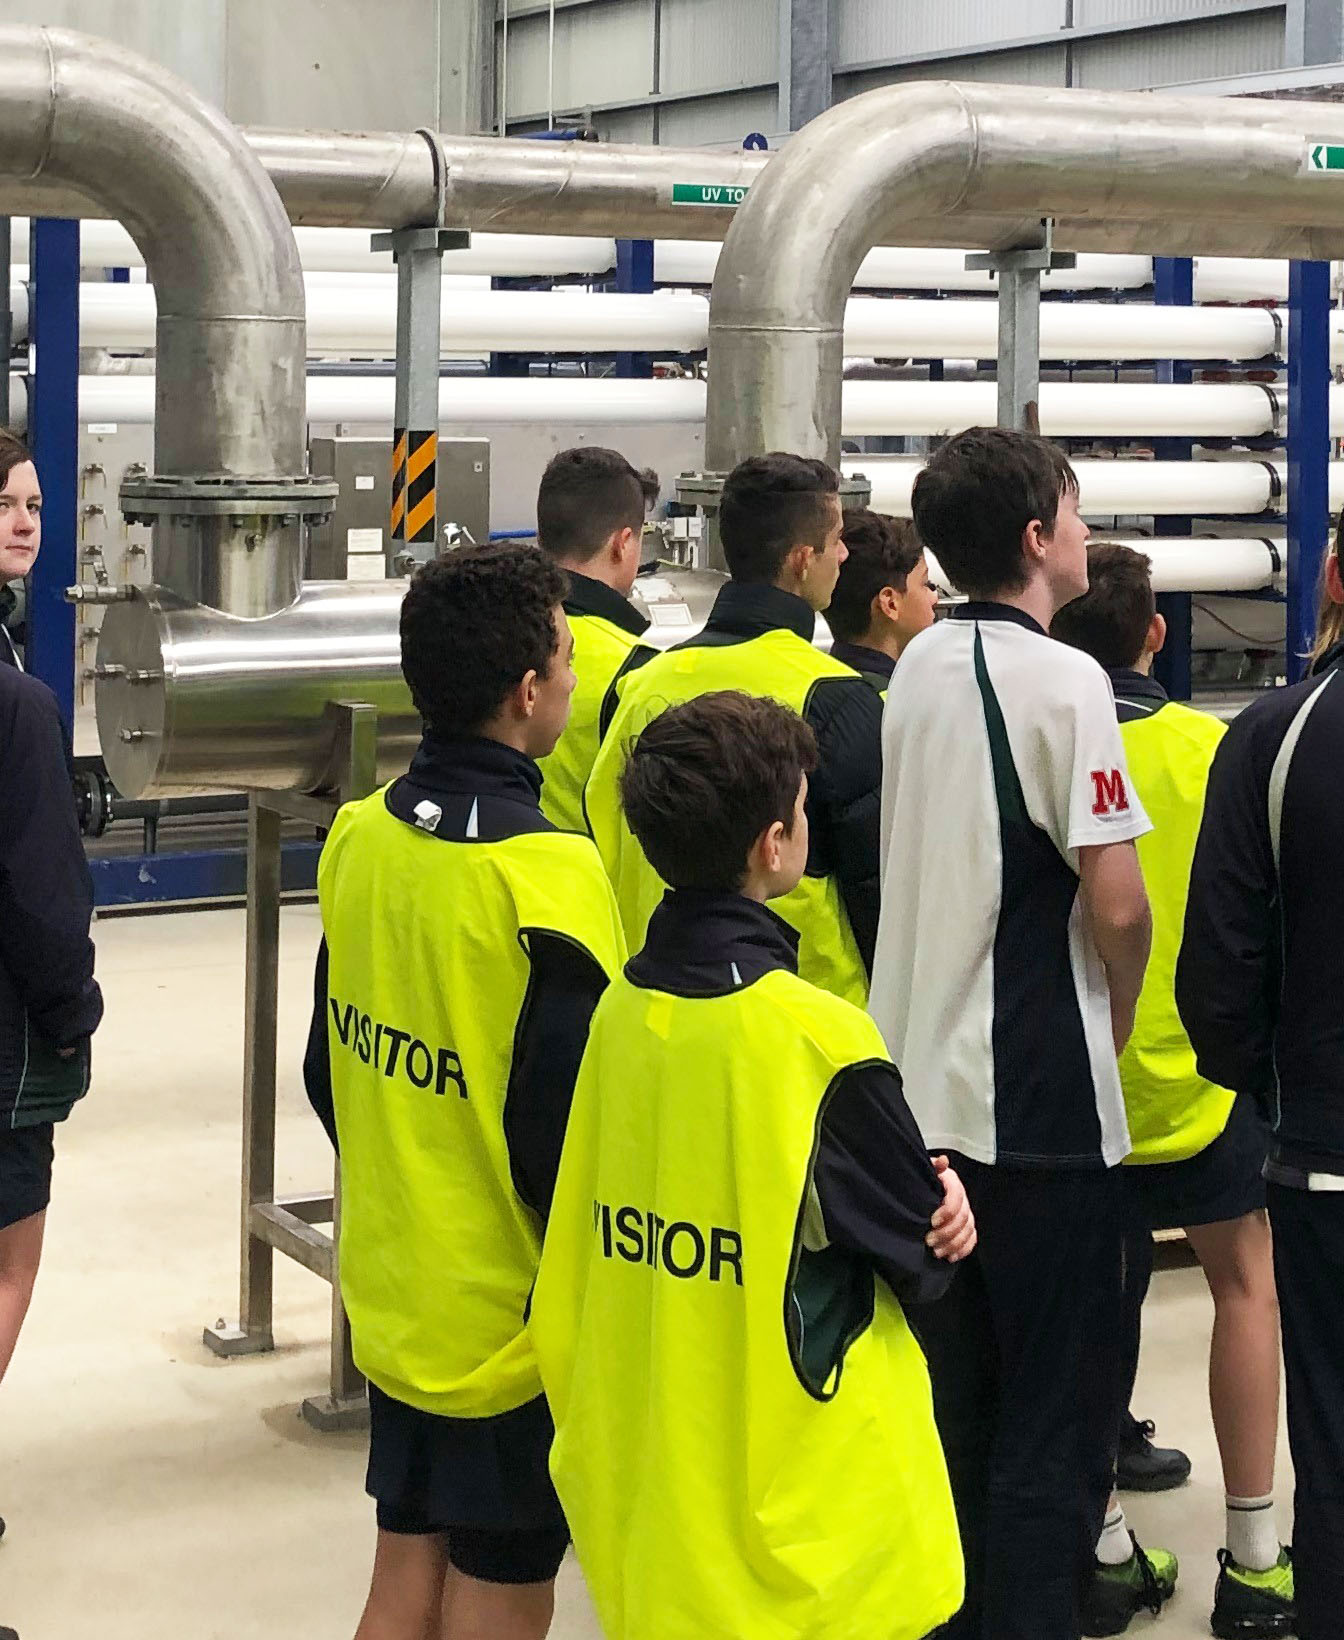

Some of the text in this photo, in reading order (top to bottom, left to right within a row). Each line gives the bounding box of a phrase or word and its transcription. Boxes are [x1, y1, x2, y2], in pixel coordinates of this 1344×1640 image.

[702, 187, 745, 203] UV TO
[1091, 768, 1129, 815] M
[329, 997, 468, 1100] VISITOR
[593, 1199, 743, 1286] VISITOR
